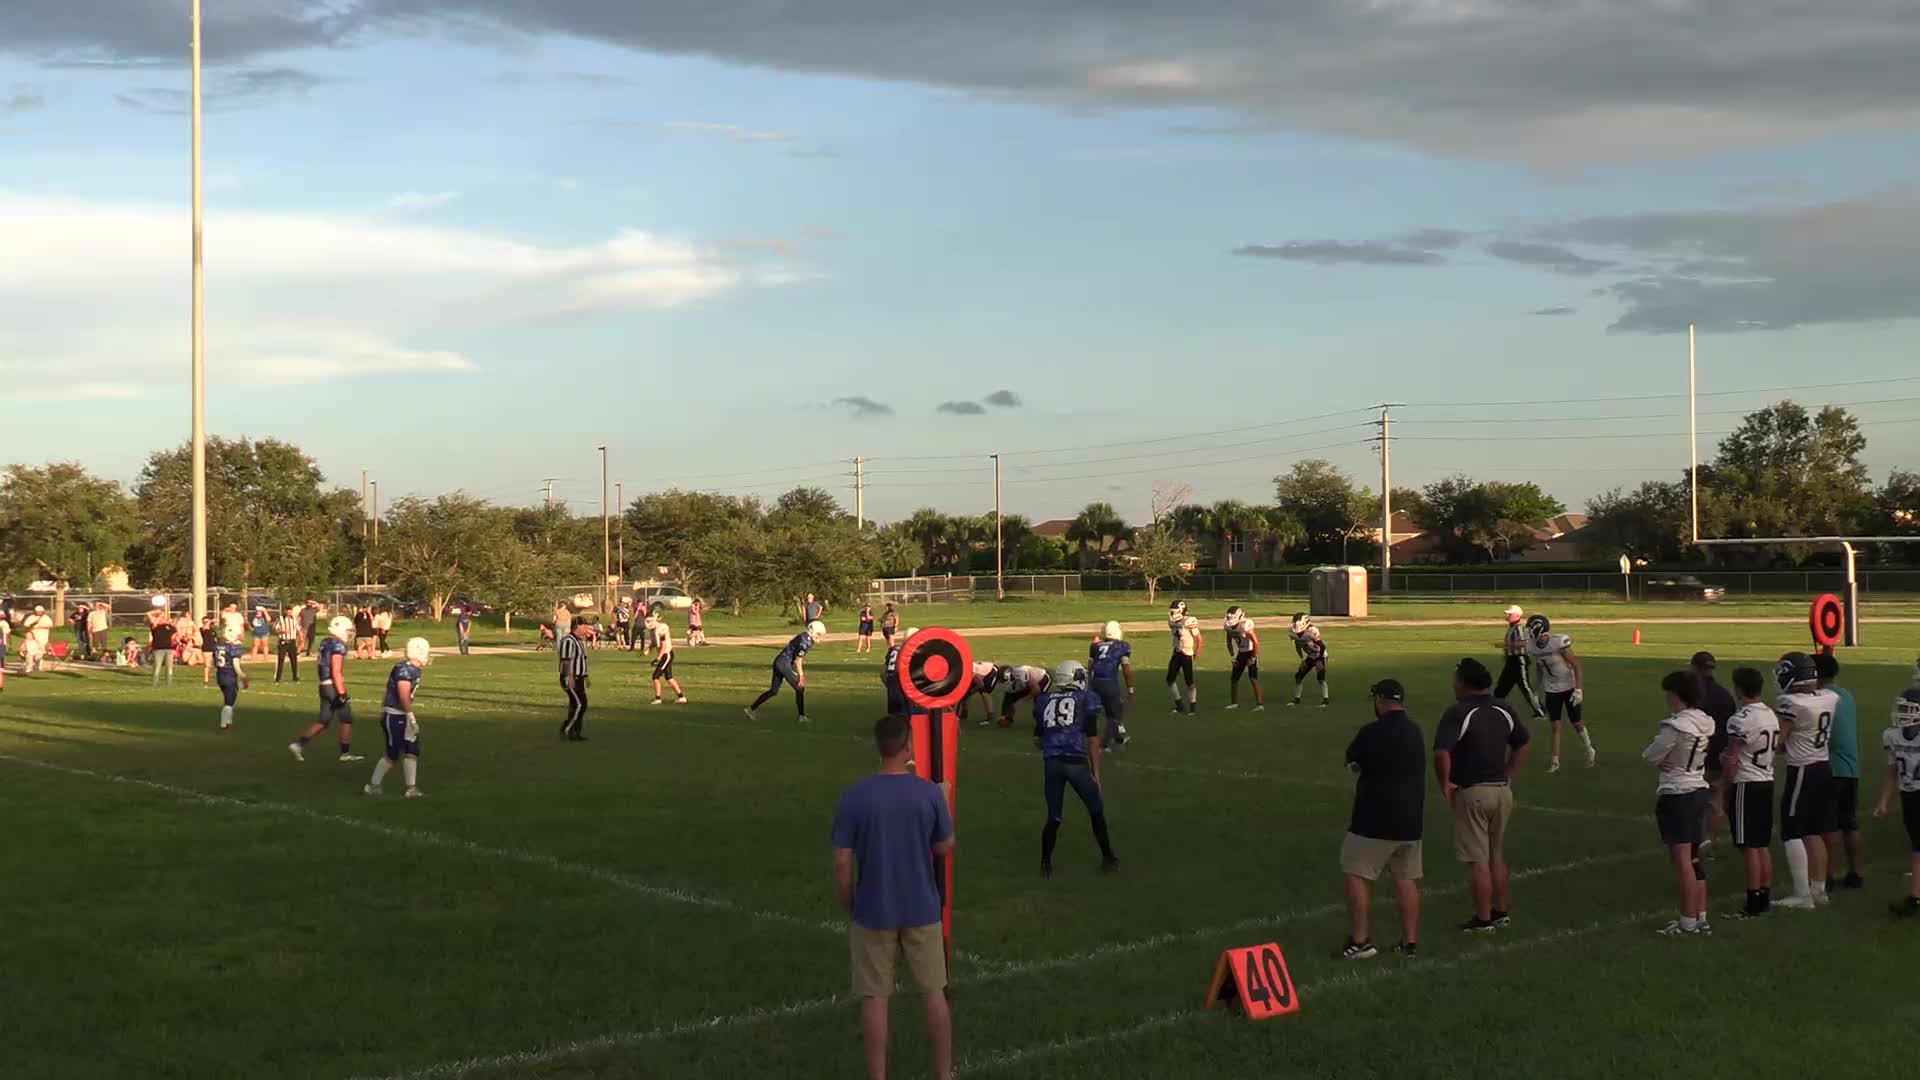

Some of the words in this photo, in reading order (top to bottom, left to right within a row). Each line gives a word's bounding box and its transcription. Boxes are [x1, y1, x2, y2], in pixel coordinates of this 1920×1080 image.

[1043, 697, 1076, 728] 49
[1815, 711, 1832, 749] 8
[1246, 948, 1291, 1011] 40
